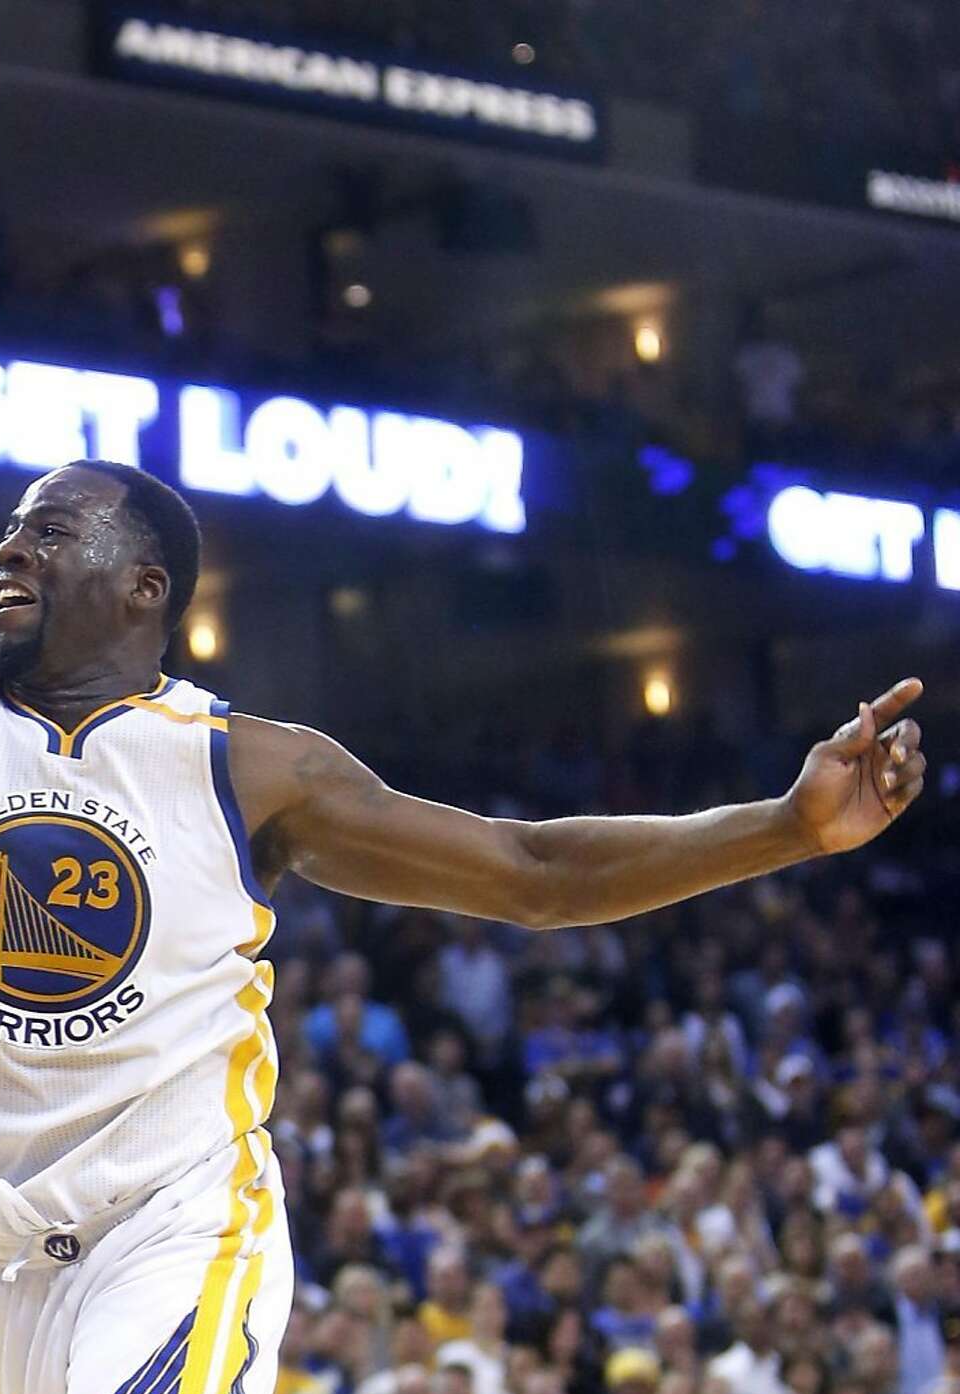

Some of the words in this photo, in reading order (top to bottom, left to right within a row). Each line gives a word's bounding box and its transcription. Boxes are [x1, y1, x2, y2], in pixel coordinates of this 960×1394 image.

[117, 19, 378, 98] AMERICAN
[384, 66, 595, 141] EXPRESS
[179, 385, 526, 533] LOUD!
[767, 486, 925, 581] GET
[81, 799, 157, 865] STATE
[47, 857, 121, 910] 23
